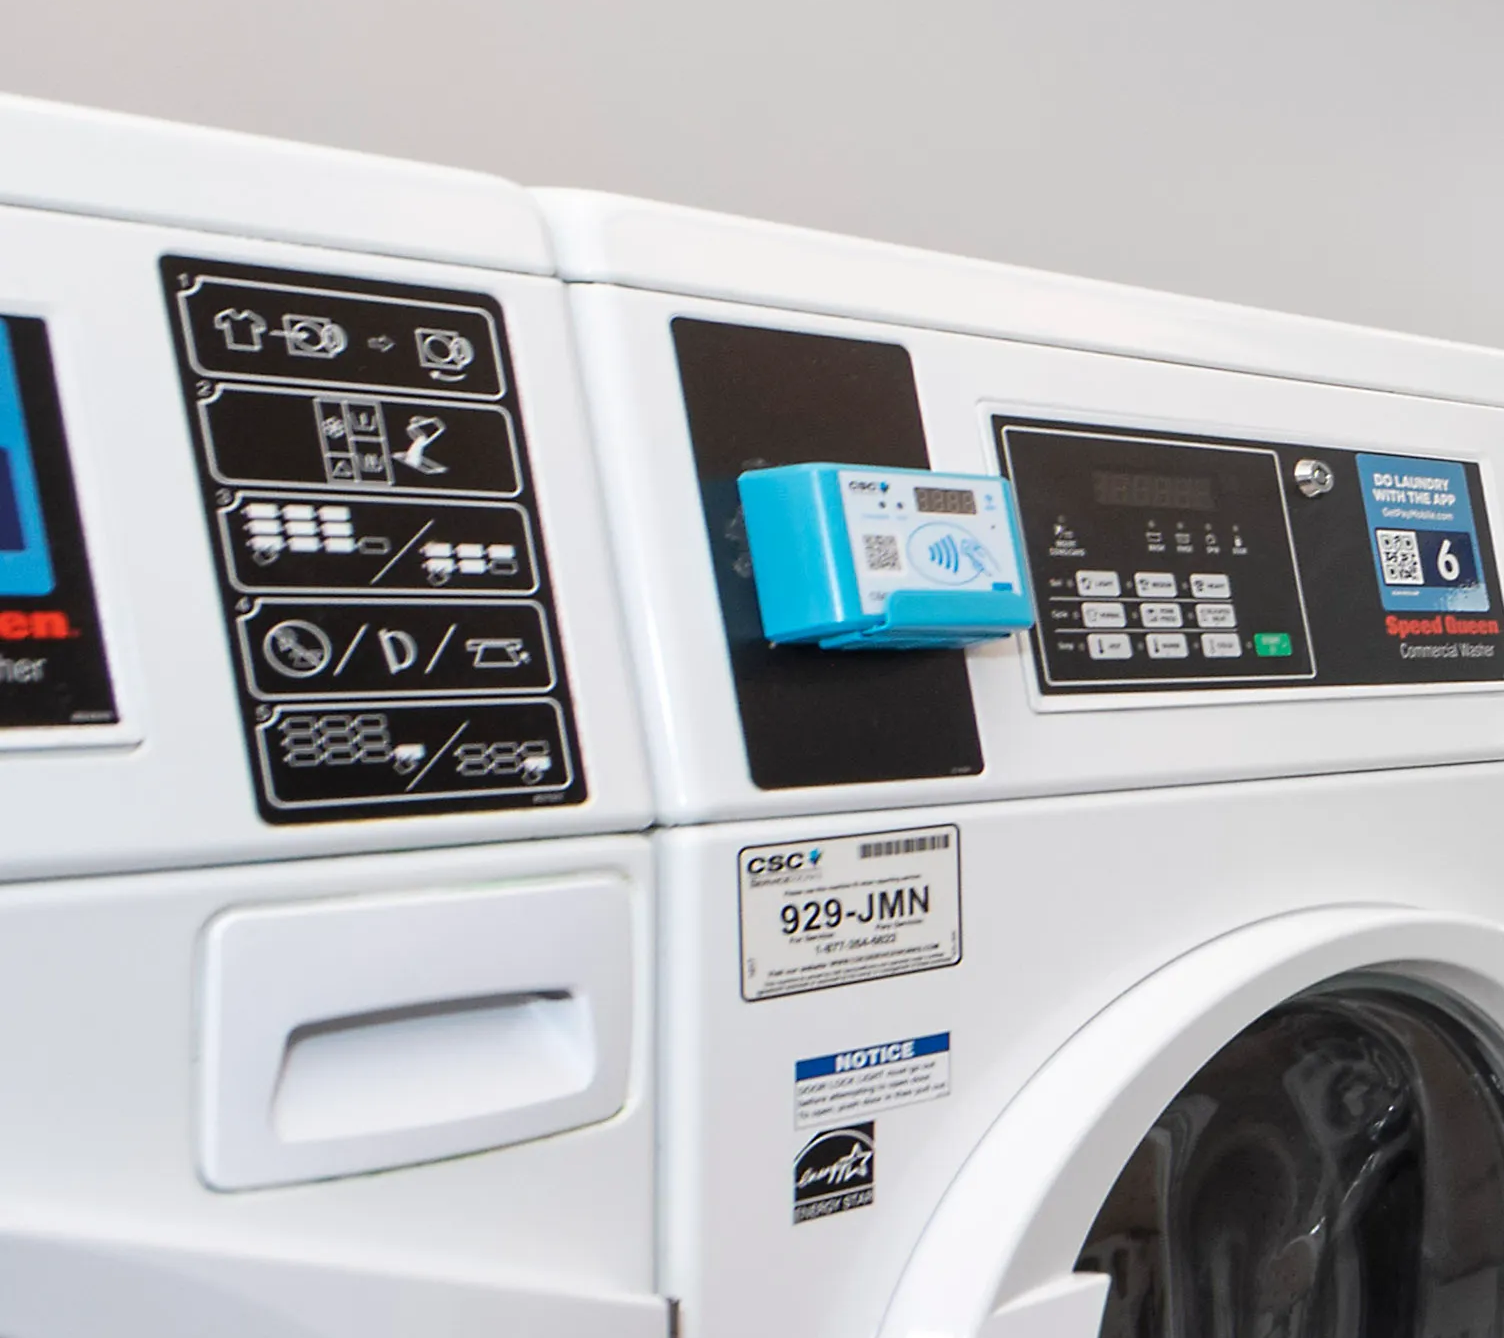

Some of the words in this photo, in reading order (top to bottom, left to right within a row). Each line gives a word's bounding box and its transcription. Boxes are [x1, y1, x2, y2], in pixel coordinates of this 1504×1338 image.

[1373, 473, 1393, 487] DO
[1394, 475, 1450, 492] LAUNDRY
[1373, 489, 1406, 504] WITH
[1407, 491, 1432, 506] THE
[1433, 493, 1456, 507] APP
[1437, 539, 1461, 582] 6
[1385, 615, 1442, 638] Speed
[1445, 616, 1499, 635] Queen
[1400, 642, 1458, 659] Commercial
[1459, 643, 1495, 658] Washer
[746, 851, 804, 875] CSC
[781, 884, 930, 935] 929-JMN
[835, 1041, 915, 1072] NOTICE
